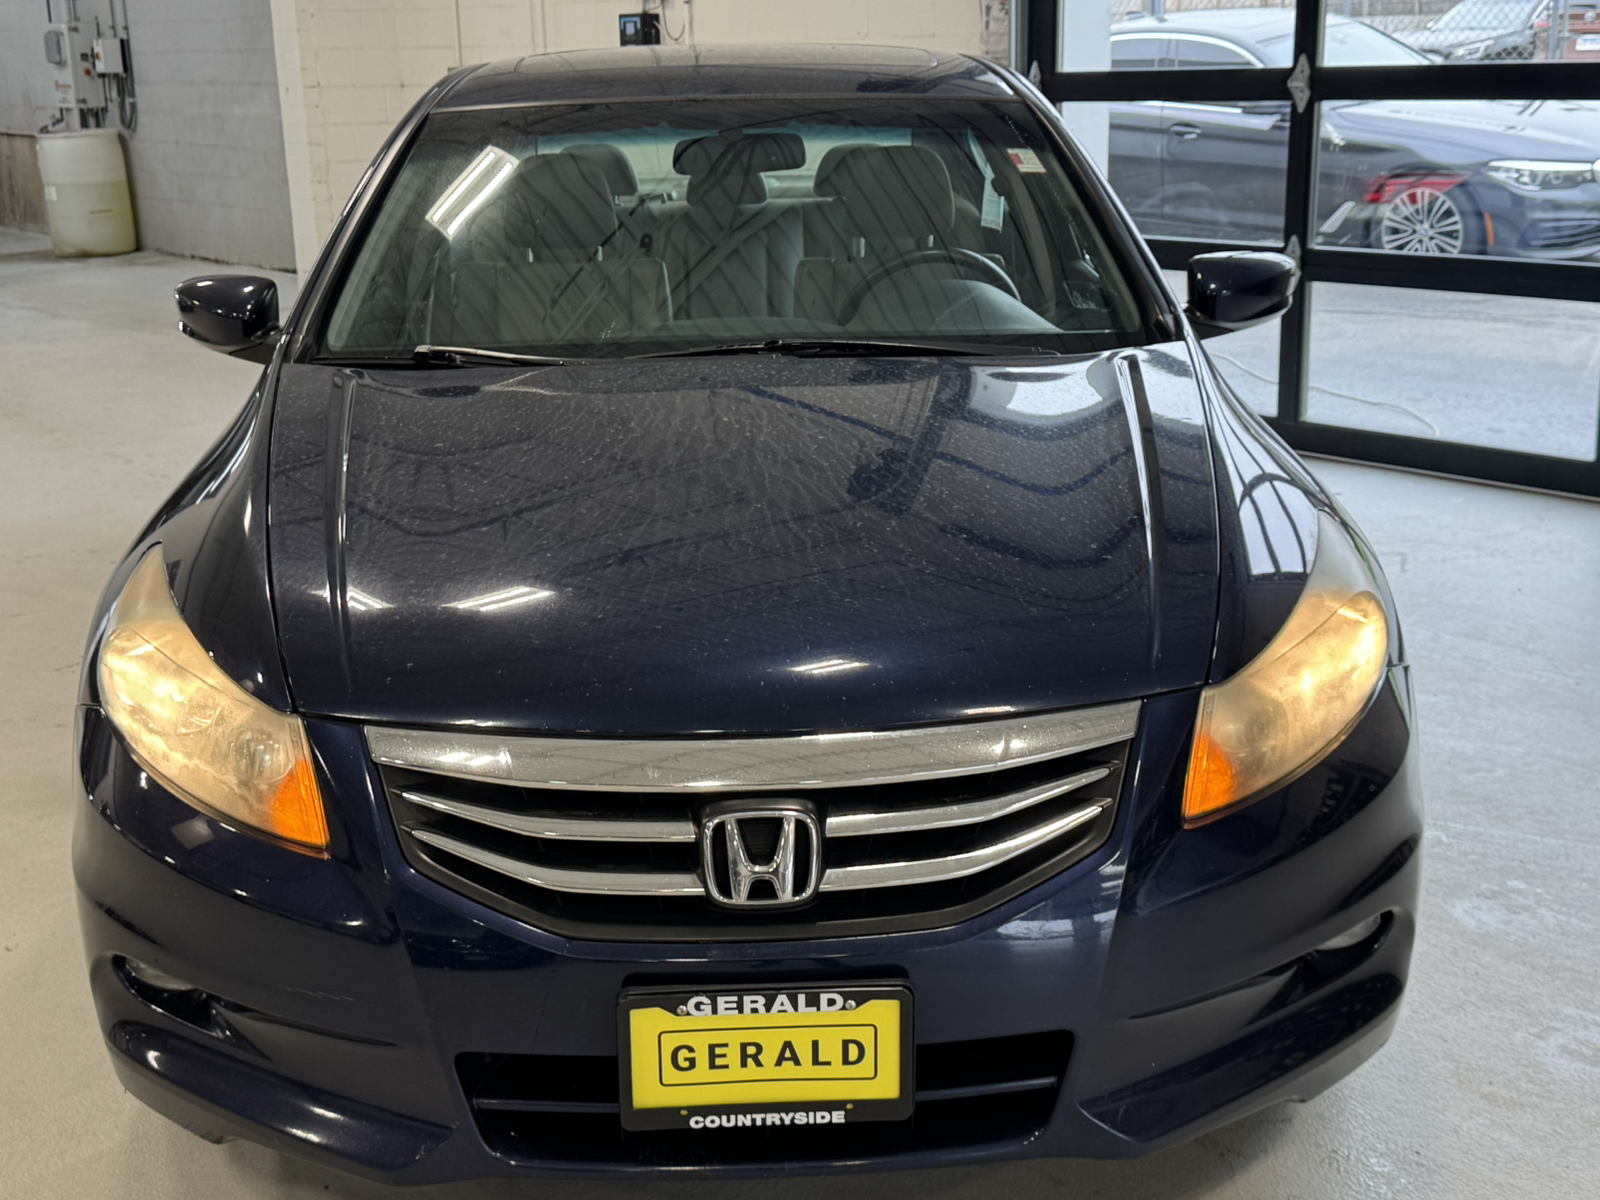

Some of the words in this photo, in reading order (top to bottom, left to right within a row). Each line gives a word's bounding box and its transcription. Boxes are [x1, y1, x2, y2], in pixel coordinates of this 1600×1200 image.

[686, 992, 845, 1016] GERALD
[670, 1038, 866, 1072] GERALD
[688, 1110, 846, 1129] COUNTRYSIDE
